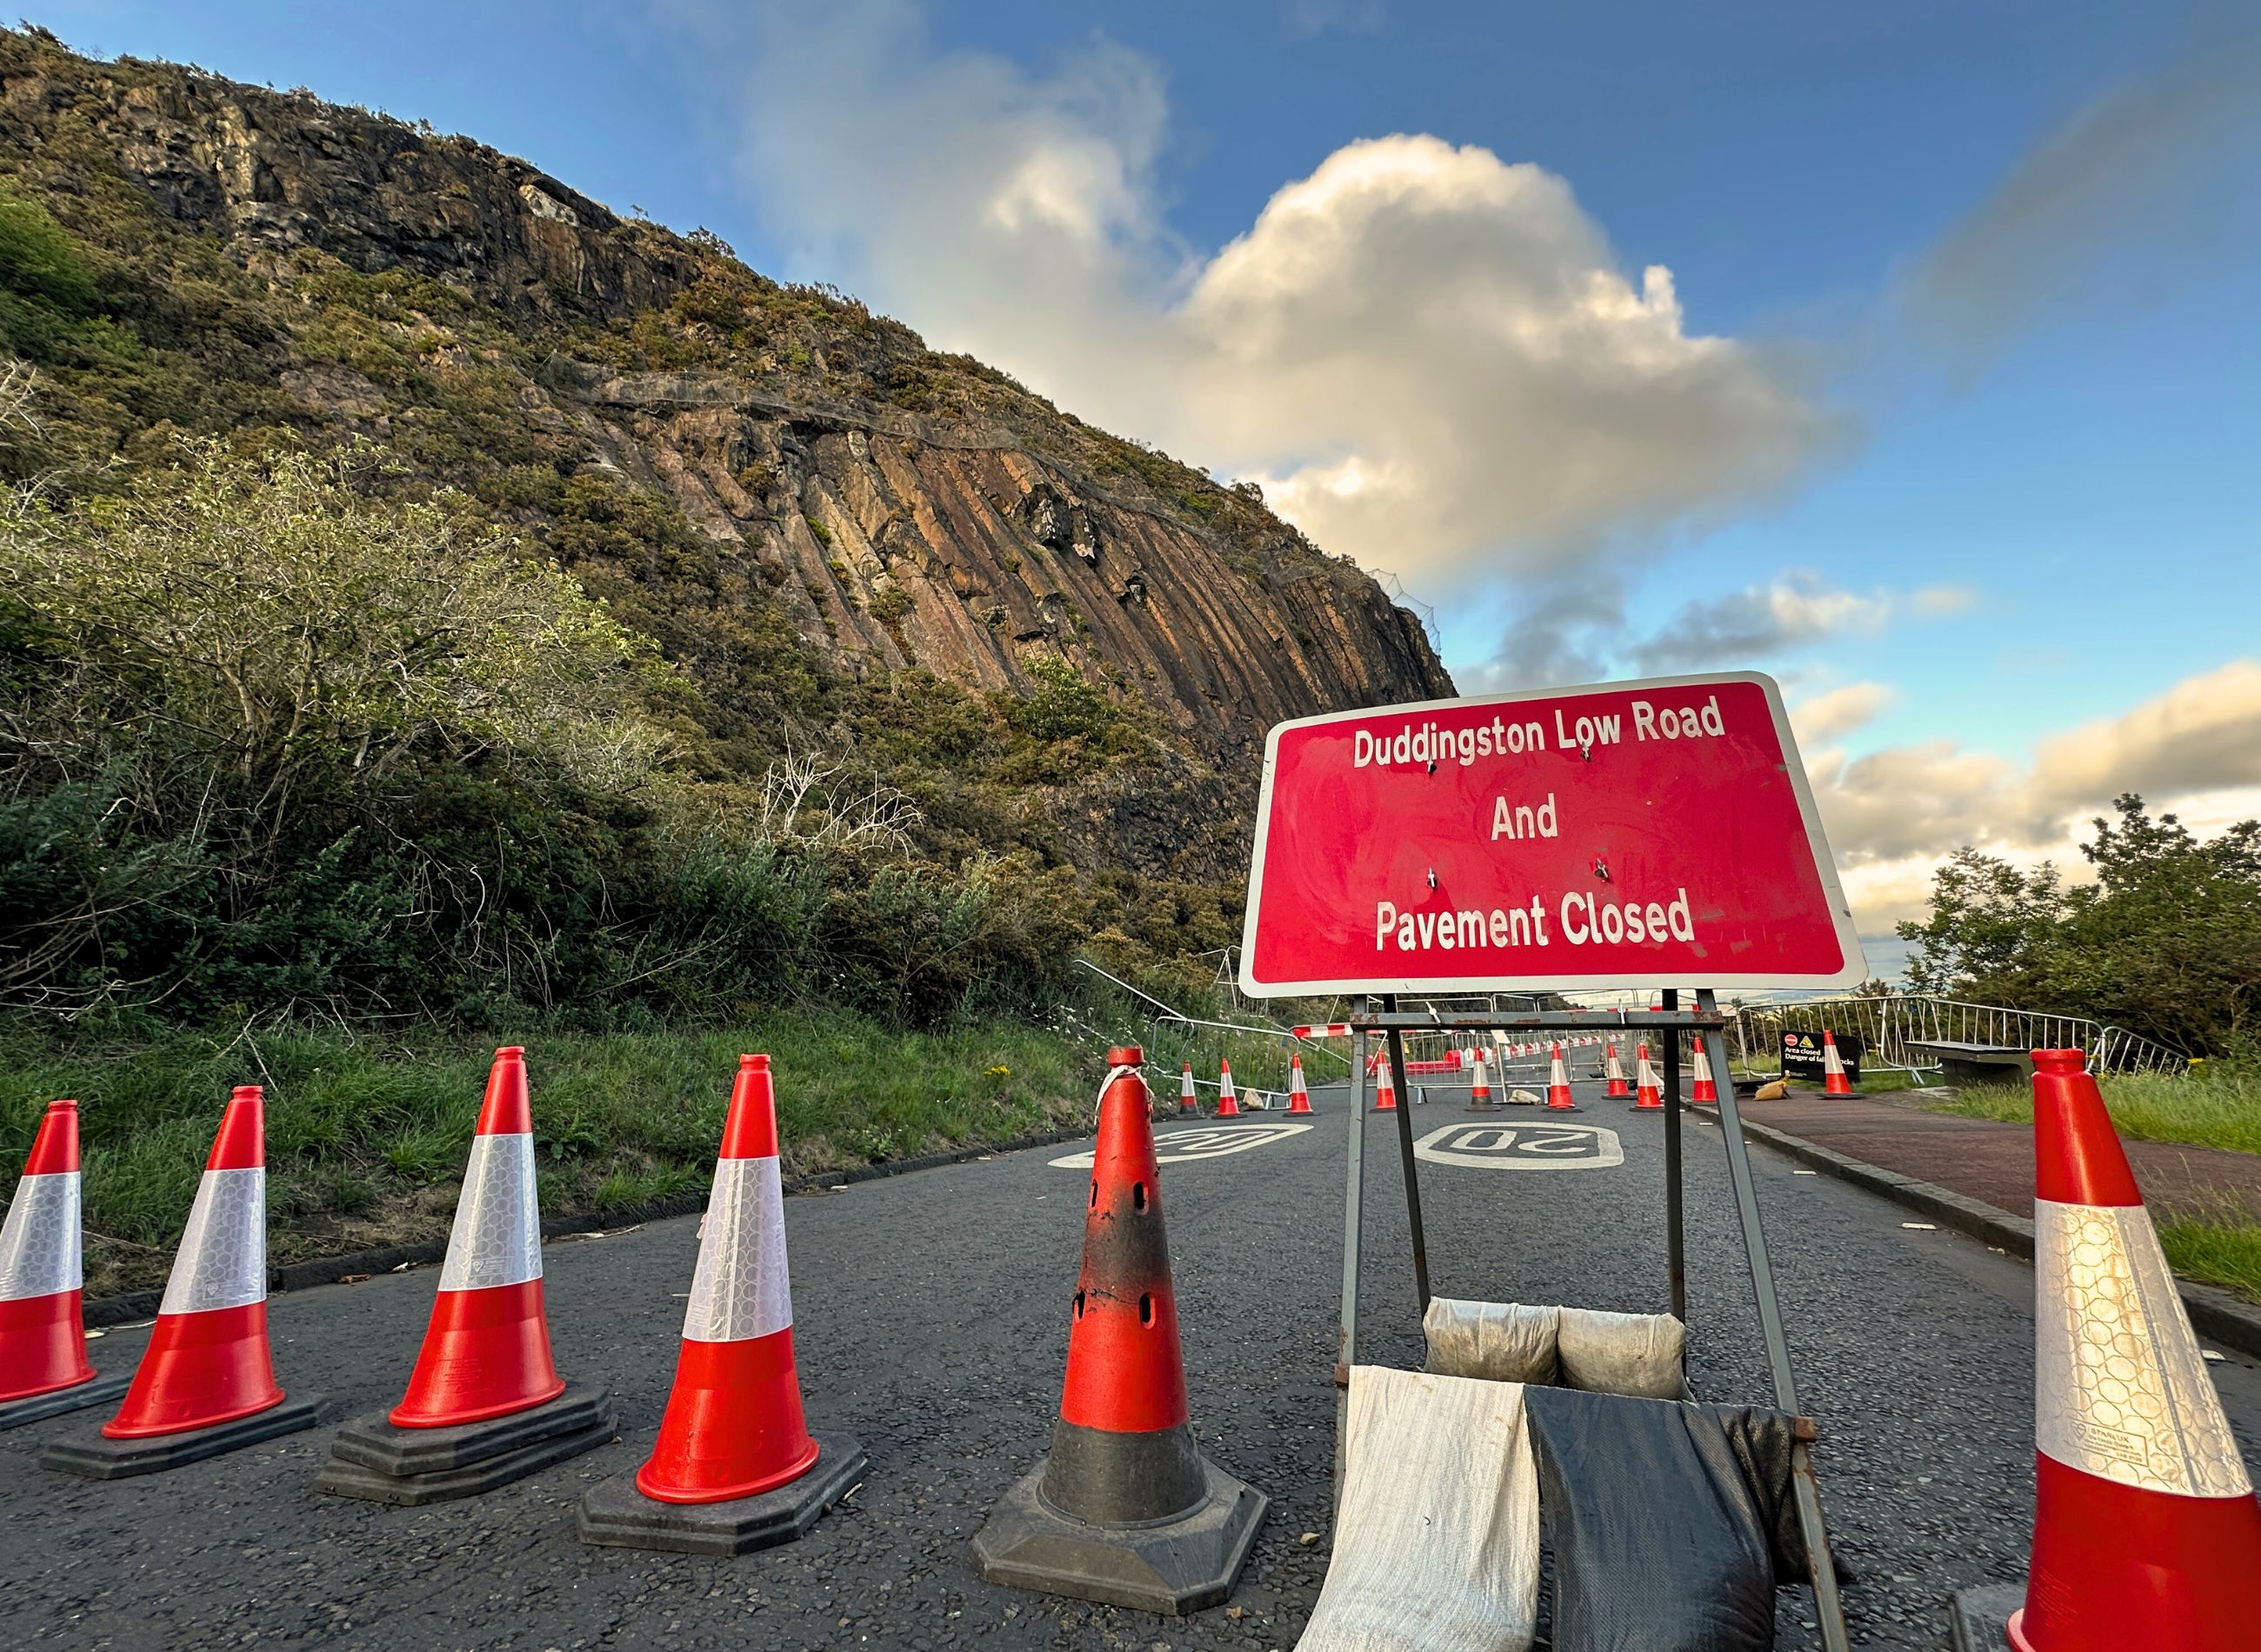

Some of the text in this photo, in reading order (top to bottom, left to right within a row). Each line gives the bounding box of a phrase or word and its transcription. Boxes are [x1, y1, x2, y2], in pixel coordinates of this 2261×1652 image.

[1353, 695, 1726, 769] Duddingston Low Road
[1491, 792, 1559, 841] And
[1376, 887, 1696, 951] Pavement Closed
[1784, 1053, 1808, 1062] Danger
[1450, 1129, 1591, 1153] 20
